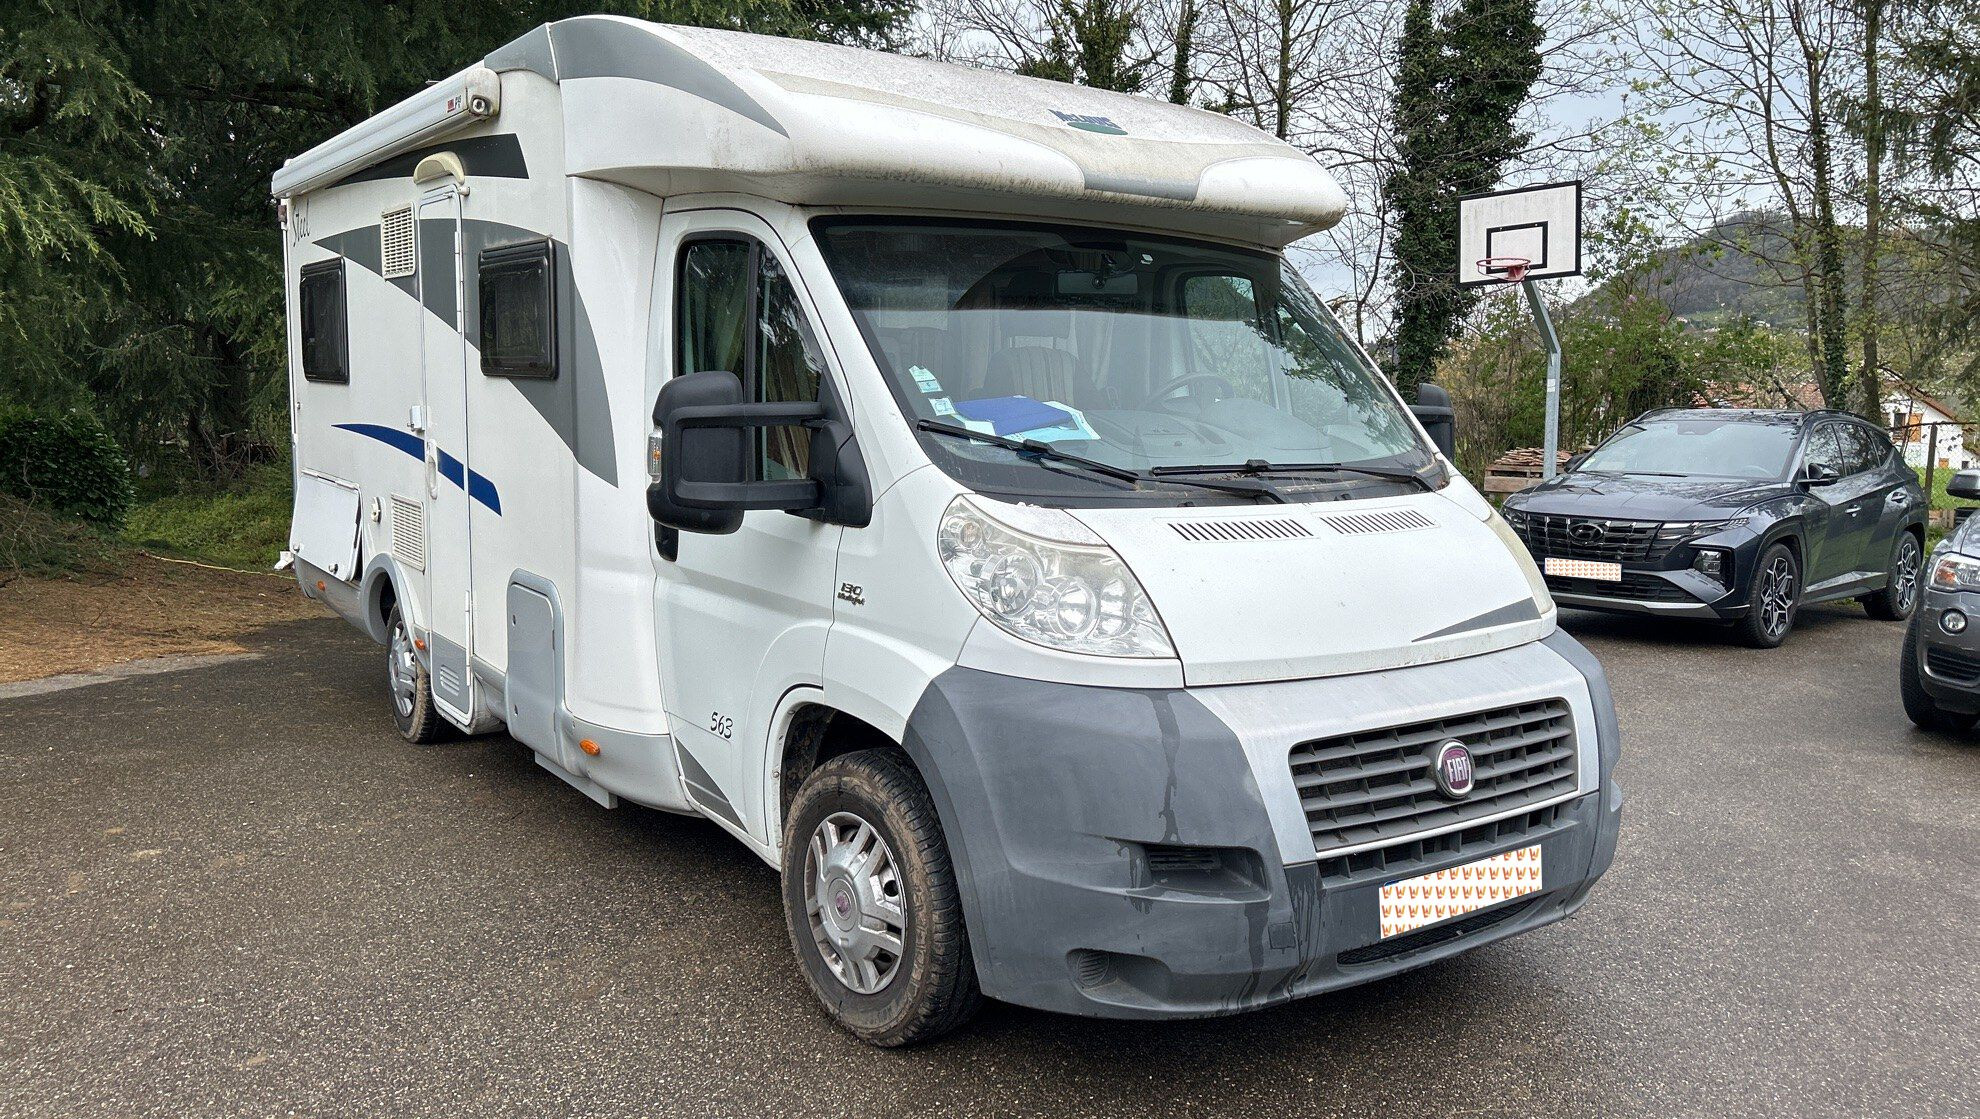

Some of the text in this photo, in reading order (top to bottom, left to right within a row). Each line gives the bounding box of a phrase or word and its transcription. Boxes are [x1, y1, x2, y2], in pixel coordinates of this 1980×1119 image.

[841, 582, 863, 596] 130
[710, 711, 733, 739] 563
[1446, 756, 1467, 783] FIAT
